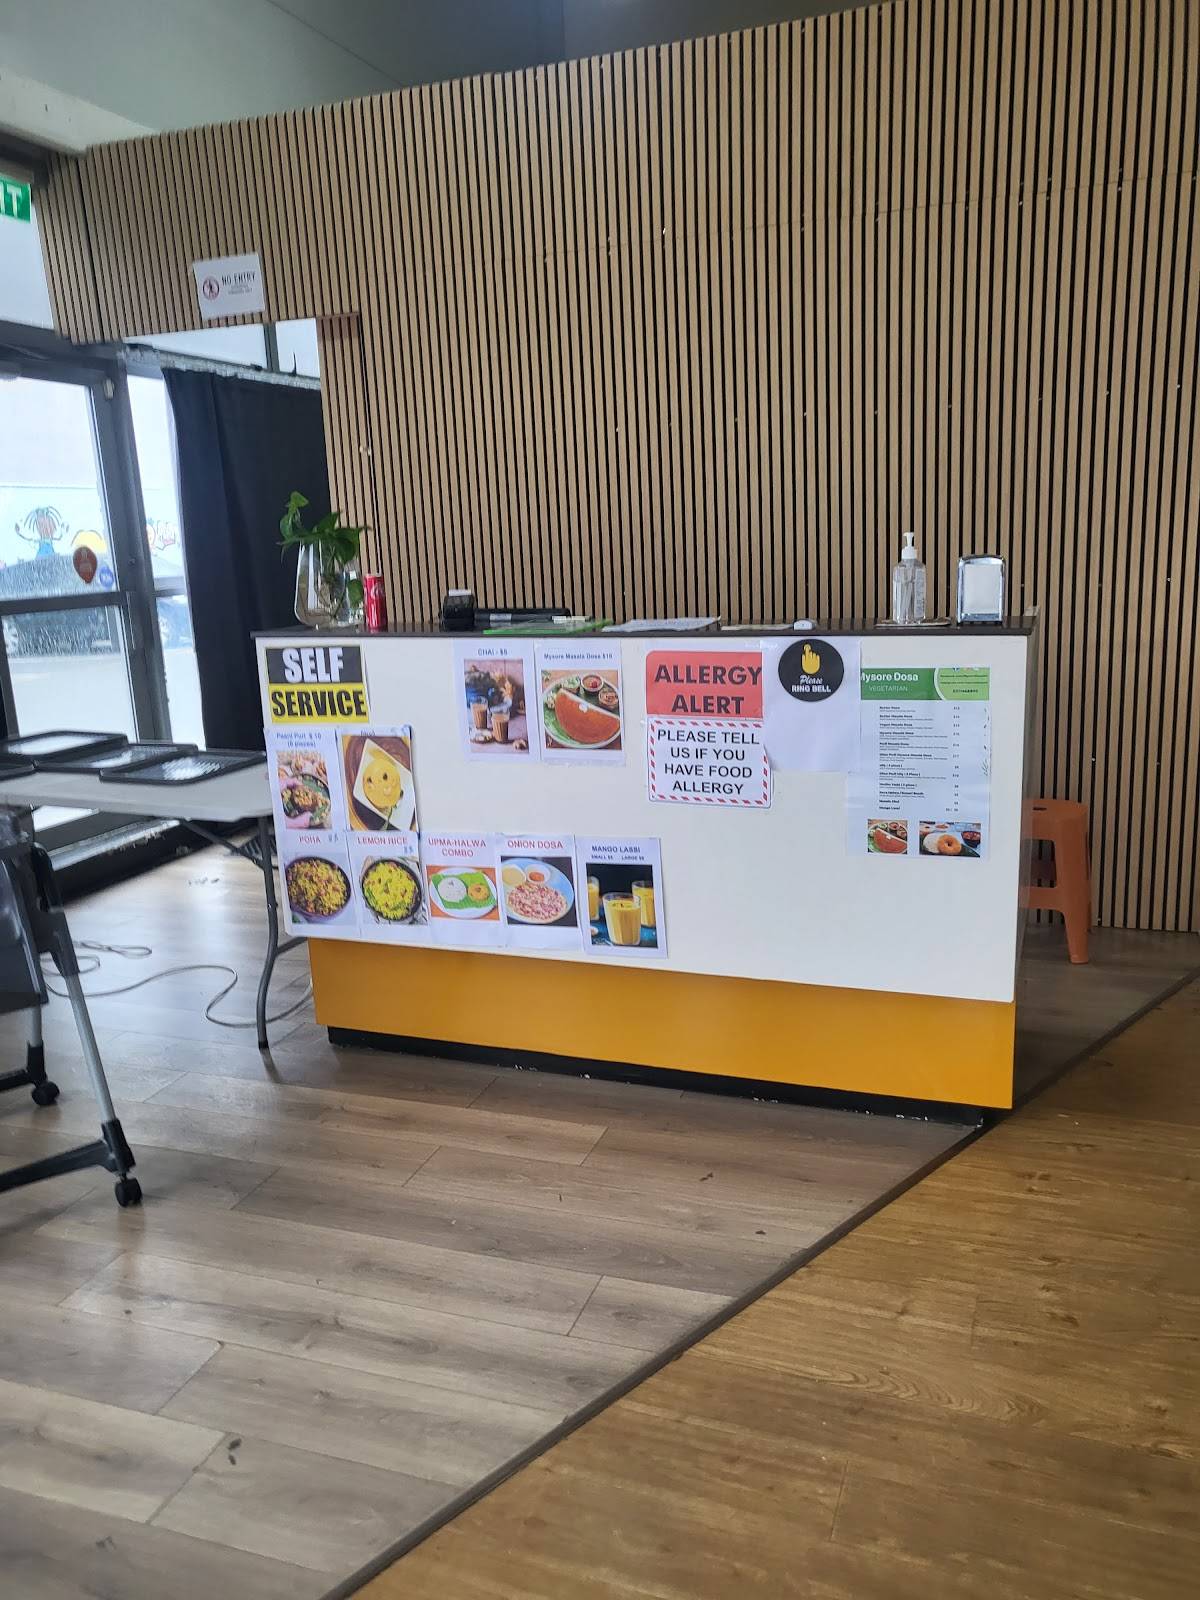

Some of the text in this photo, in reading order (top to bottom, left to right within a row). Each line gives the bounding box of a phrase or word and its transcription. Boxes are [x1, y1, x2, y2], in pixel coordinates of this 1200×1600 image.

[222, 271, 256, 286] NO ENTRY
[477, 648, 494, 656] CHAI
[544, 653, 565, 661] Mysore
[282, 646, 344, 683] SELF
[654, 664, 763, 686] ALLERGY
[799, 674, 823, 684] Please
[893, 671, 919, 682] Dosa
[791, 684, 832, 693] RING BELL
[271, 689, 367, 717] SERVICE
[671, 694, 745, 715] ALERT
[657, 729, 760, 745] PLEASE TELL
[670, 747, 745, 761] US IF YOU
[664, 763, 753, 778] HAVE FOOD
[672, 780, 744, 795] ALLERGY
[299, 836, 321, 844] POHA
[357, 836, 408, 845] LEMON RICE
[428, 838, 487, 848] UPMA-HALWA
[507, 840, 564, 849] ONION DOSA
[441, 848, 474, 857] COMBO
[591, 845, 618, 853] MANGO
